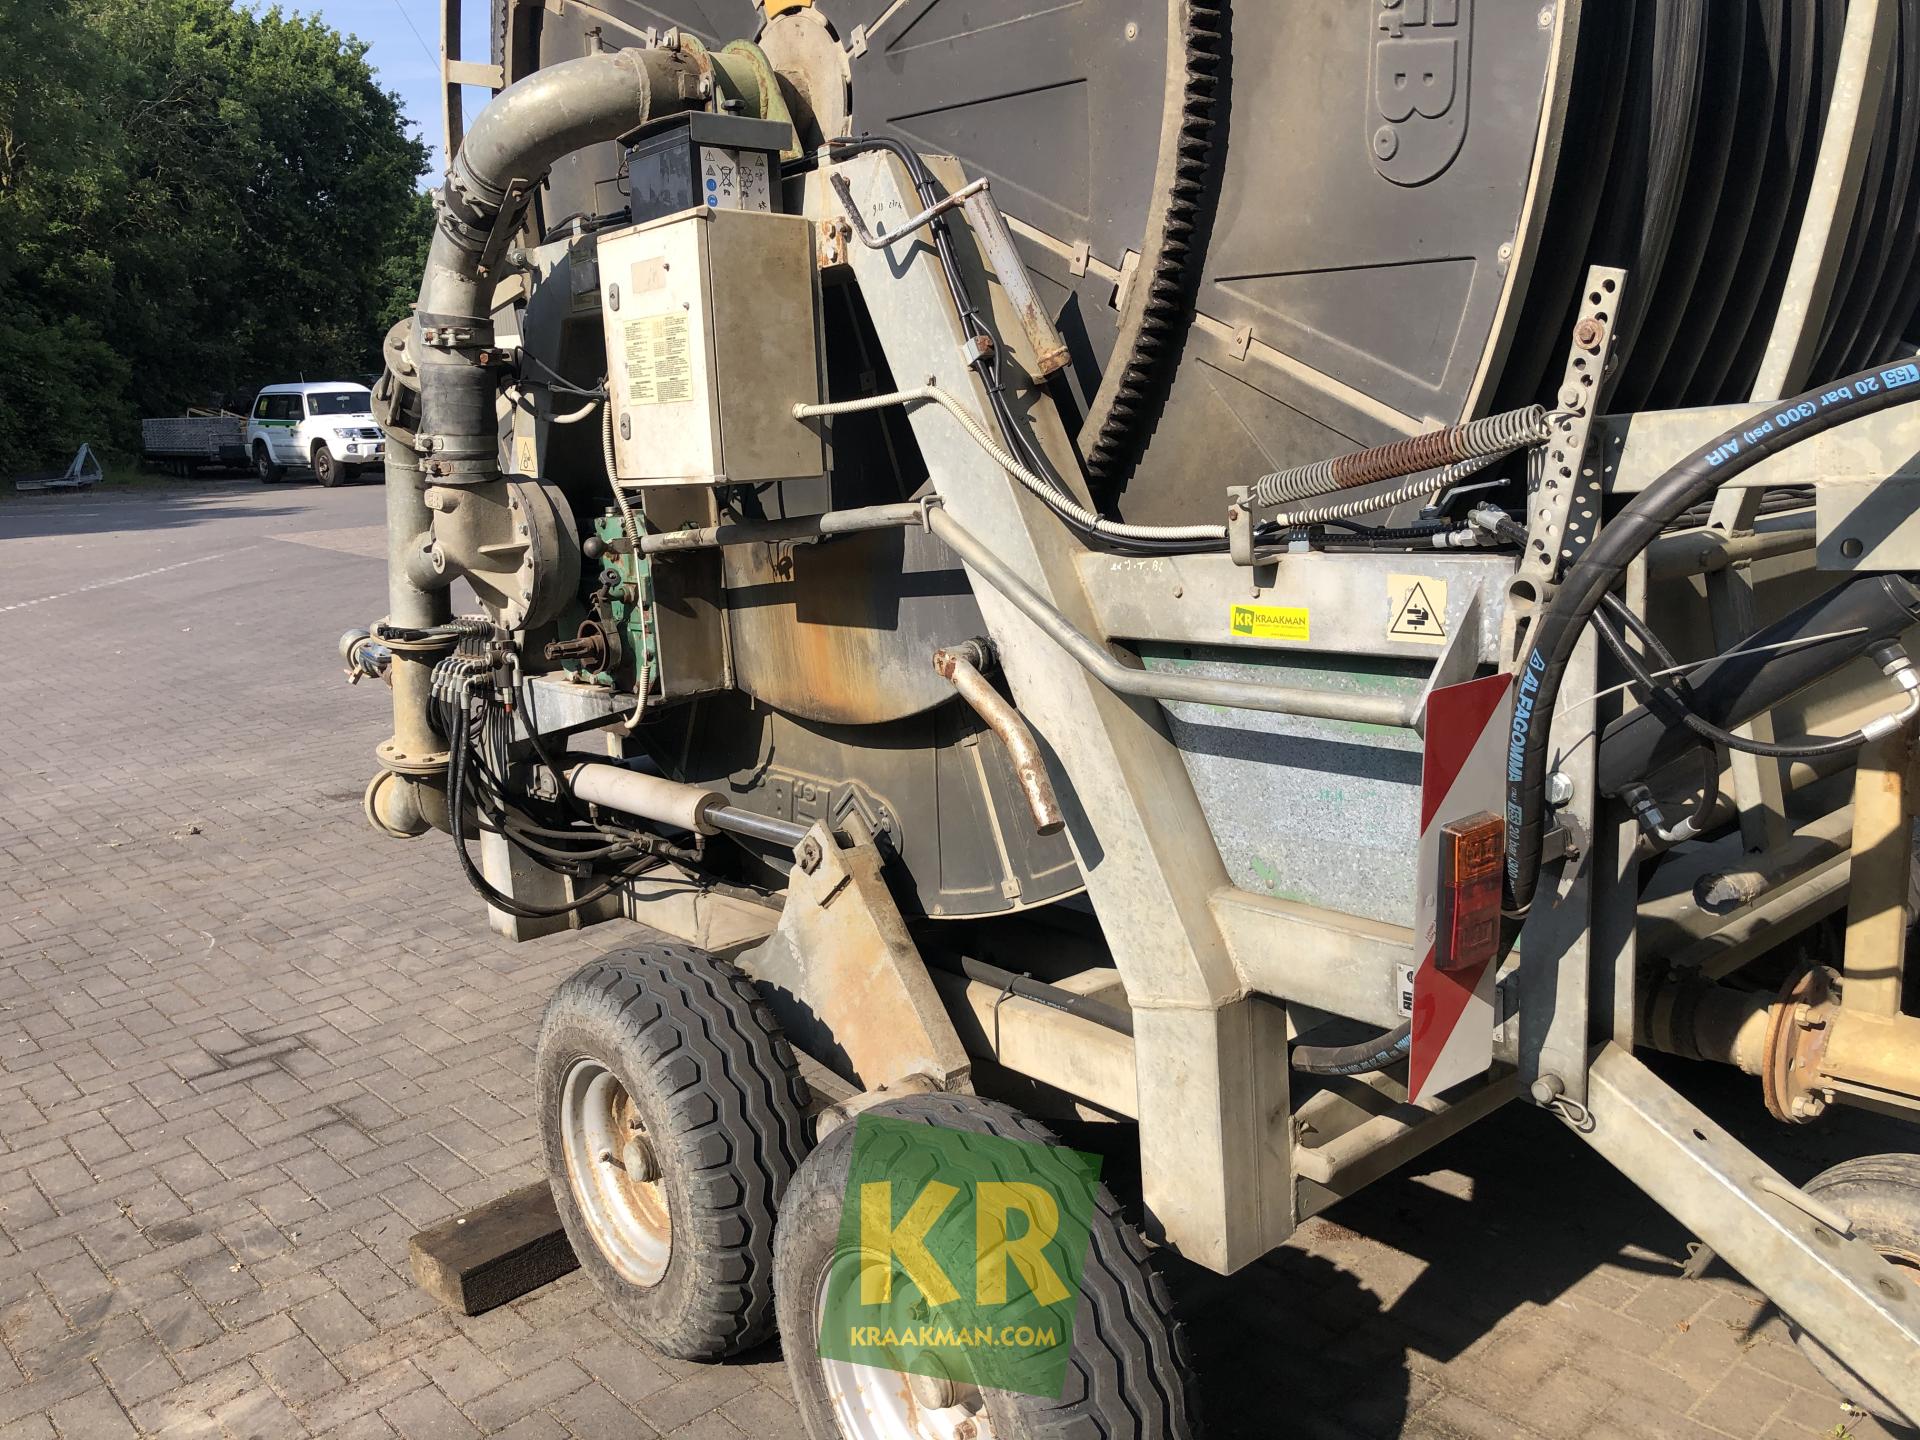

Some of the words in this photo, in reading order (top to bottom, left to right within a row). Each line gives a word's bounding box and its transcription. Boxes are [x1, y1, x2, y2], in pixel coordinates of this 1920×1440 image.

[1854, 376, 1879, 395] 20
[1884, 365, 1918, 387] 155
[1820, 386, 1853, 407] bar
[1775, 401, 1817, 428] (300
[1743, 420, 1773, 445] psi)
[1704, 438, 1740, 467] AIR
[1235, 612, 1252, 626] KR
[1255, 614, 1306, 625] KRAAKMAN
[1508, 666, 1539, 782] ALFAGOMMA
[1509, 825, 1520, 839] 20
[1508, 840, 1520, 857] bar
